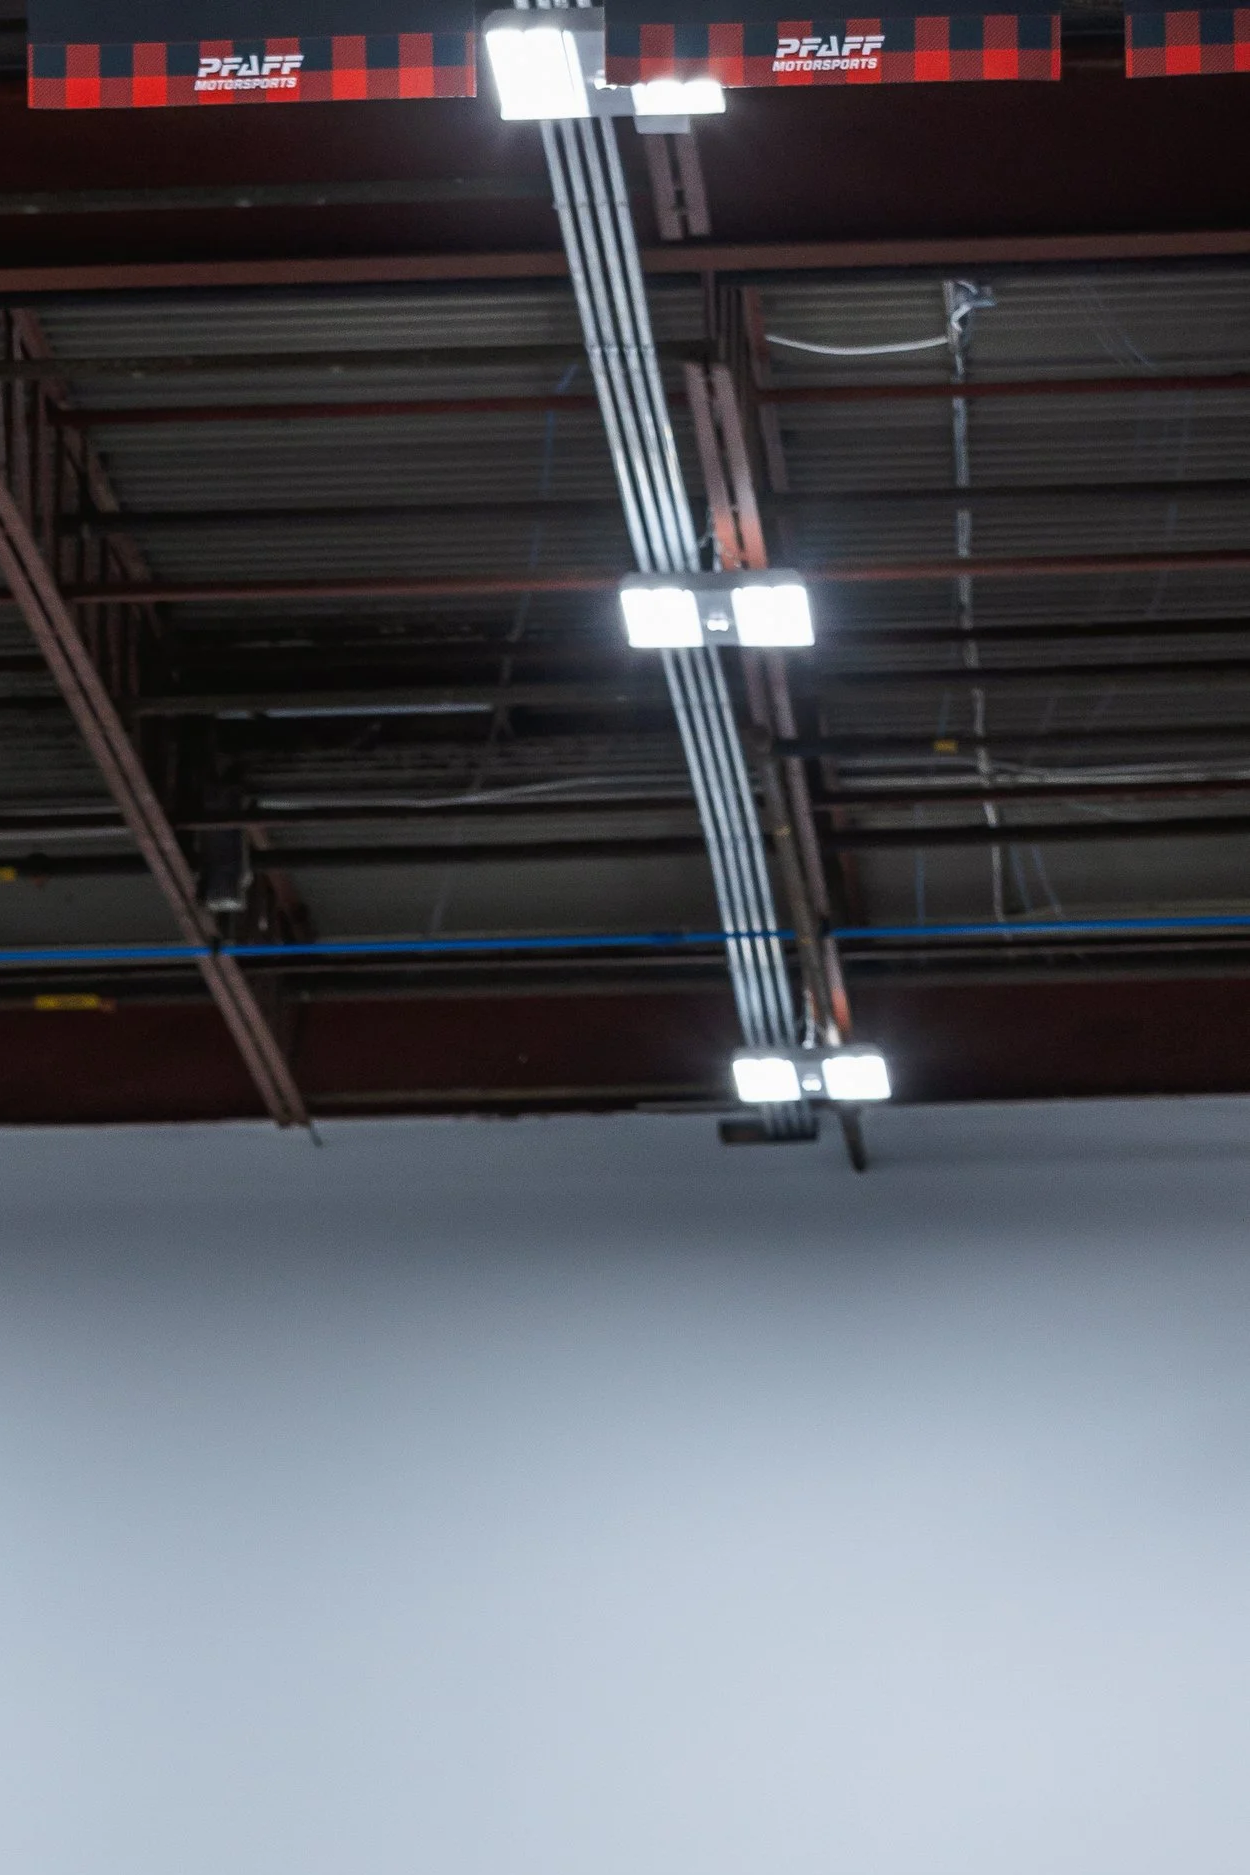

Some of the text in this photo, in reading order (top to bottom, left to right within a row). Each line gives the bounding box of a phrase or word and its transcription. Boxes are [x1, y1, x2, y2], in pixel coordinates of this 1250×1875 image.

[775, 35, 885, 58] PFAFF
[197, 55, 304, 77] PFAFF
[772, 58, 877, 72] MOTORSPORTS
[194, 77, 297, 91] MOTORSPORTS
